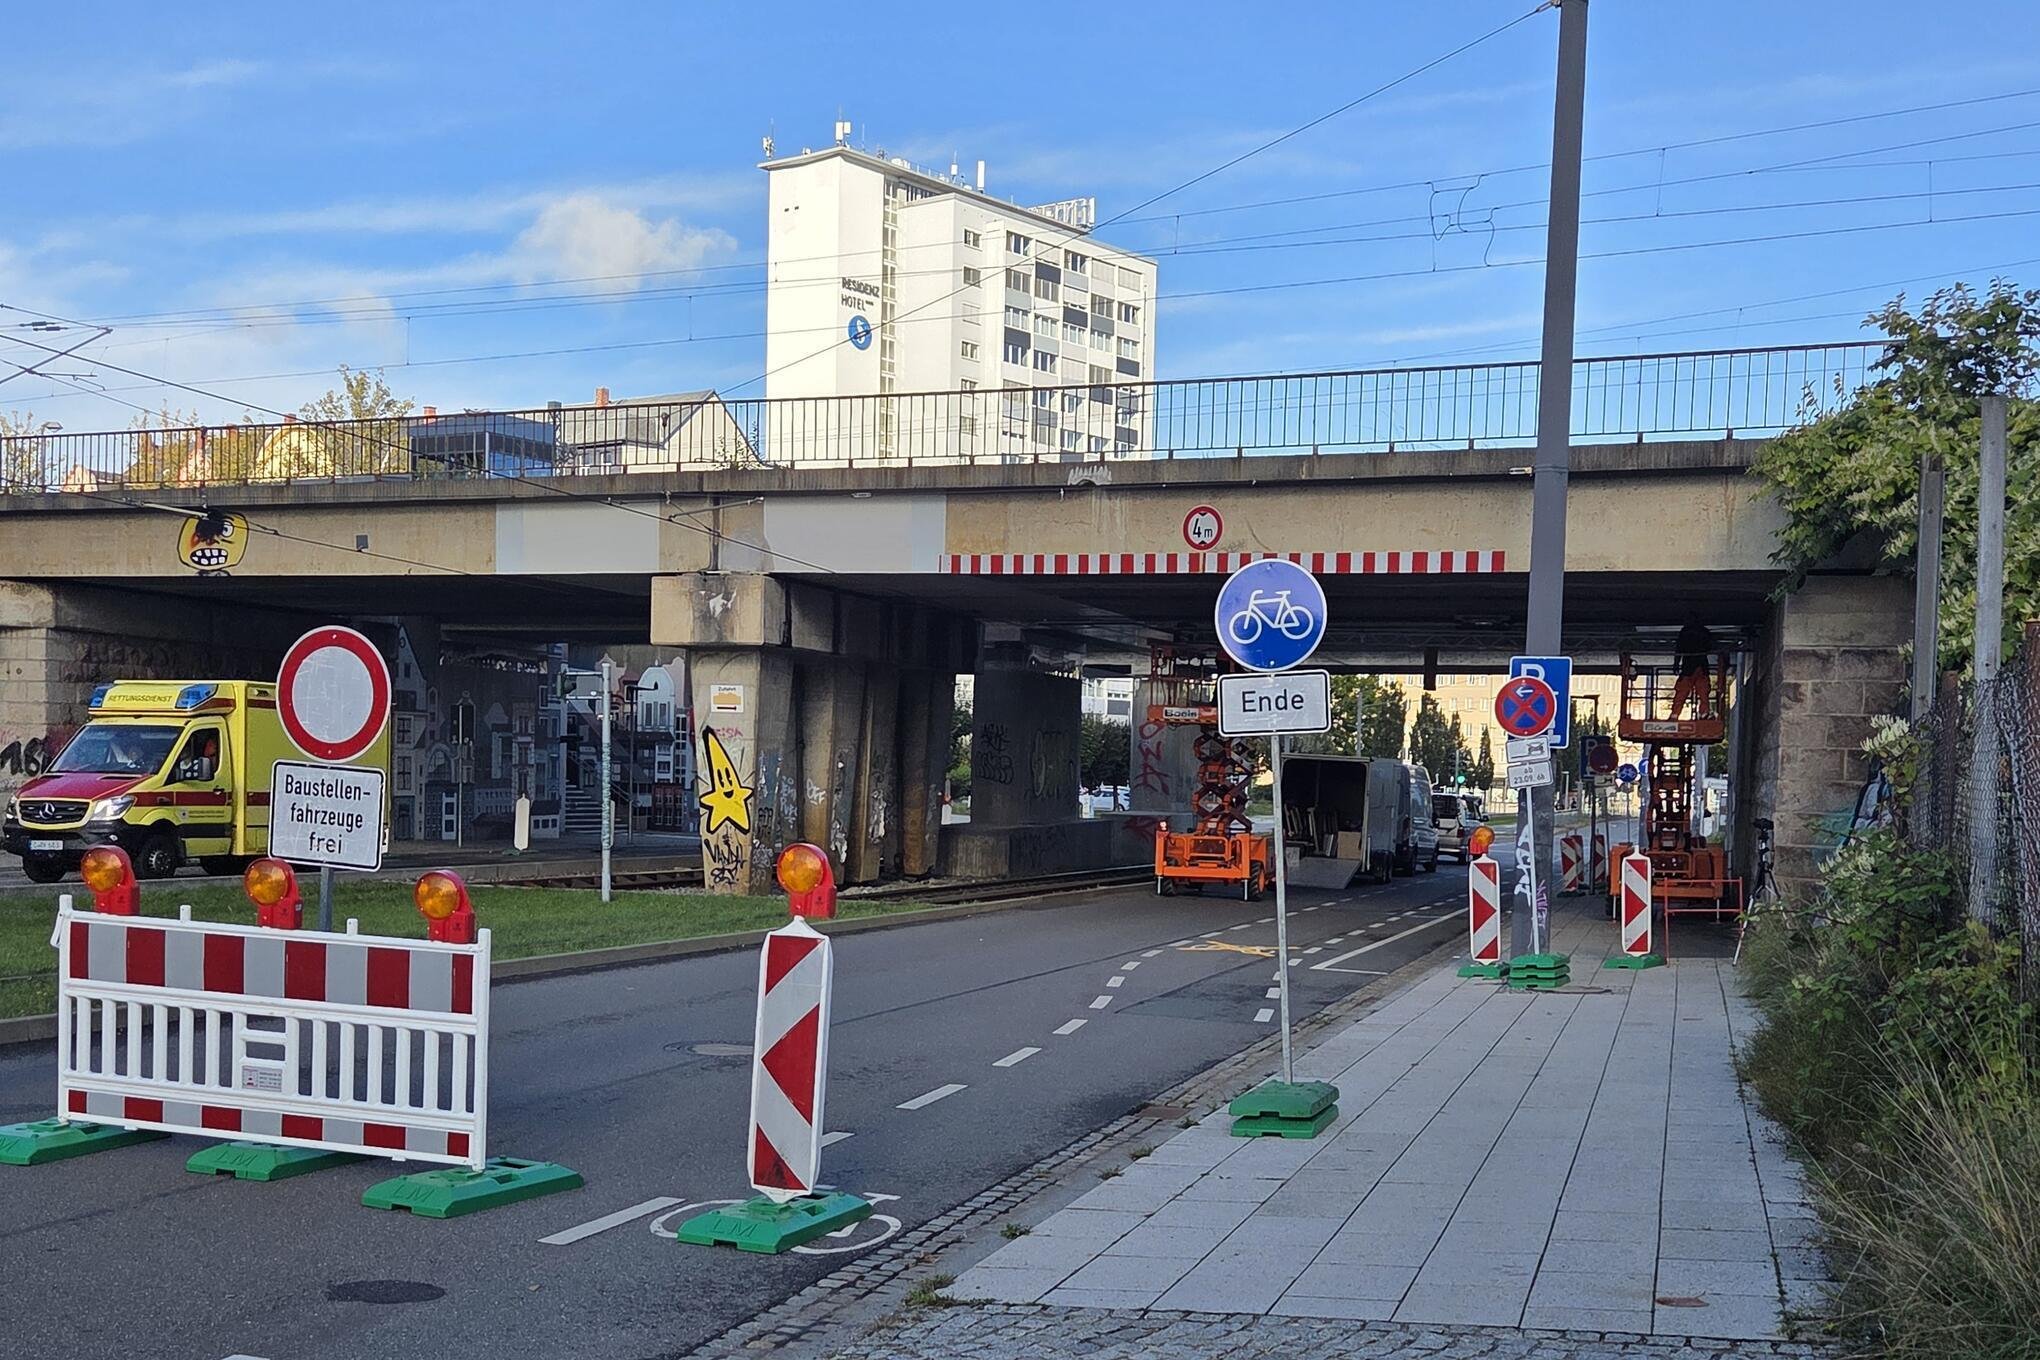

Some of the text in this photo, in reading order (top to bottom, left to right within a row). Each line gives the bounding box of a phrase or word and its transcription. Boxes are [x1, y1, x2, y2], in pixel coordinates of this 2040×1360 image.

[841, 277, 880, 298] RESIDENZ
[841, 293, 866, 311] HOTEL
[1192, 517, 1213, 538] 4 m
[107, 694, 173, 703] RETTUNGSDIENST
[1241, 688, 1304, 713] Ende
[285, 774, 371, 801] Baustellen-
[290, 802, 363, 833] fahrzeuge
[309, 831, 343, 855] frei
[710, 1218, 759, 1237] LM
